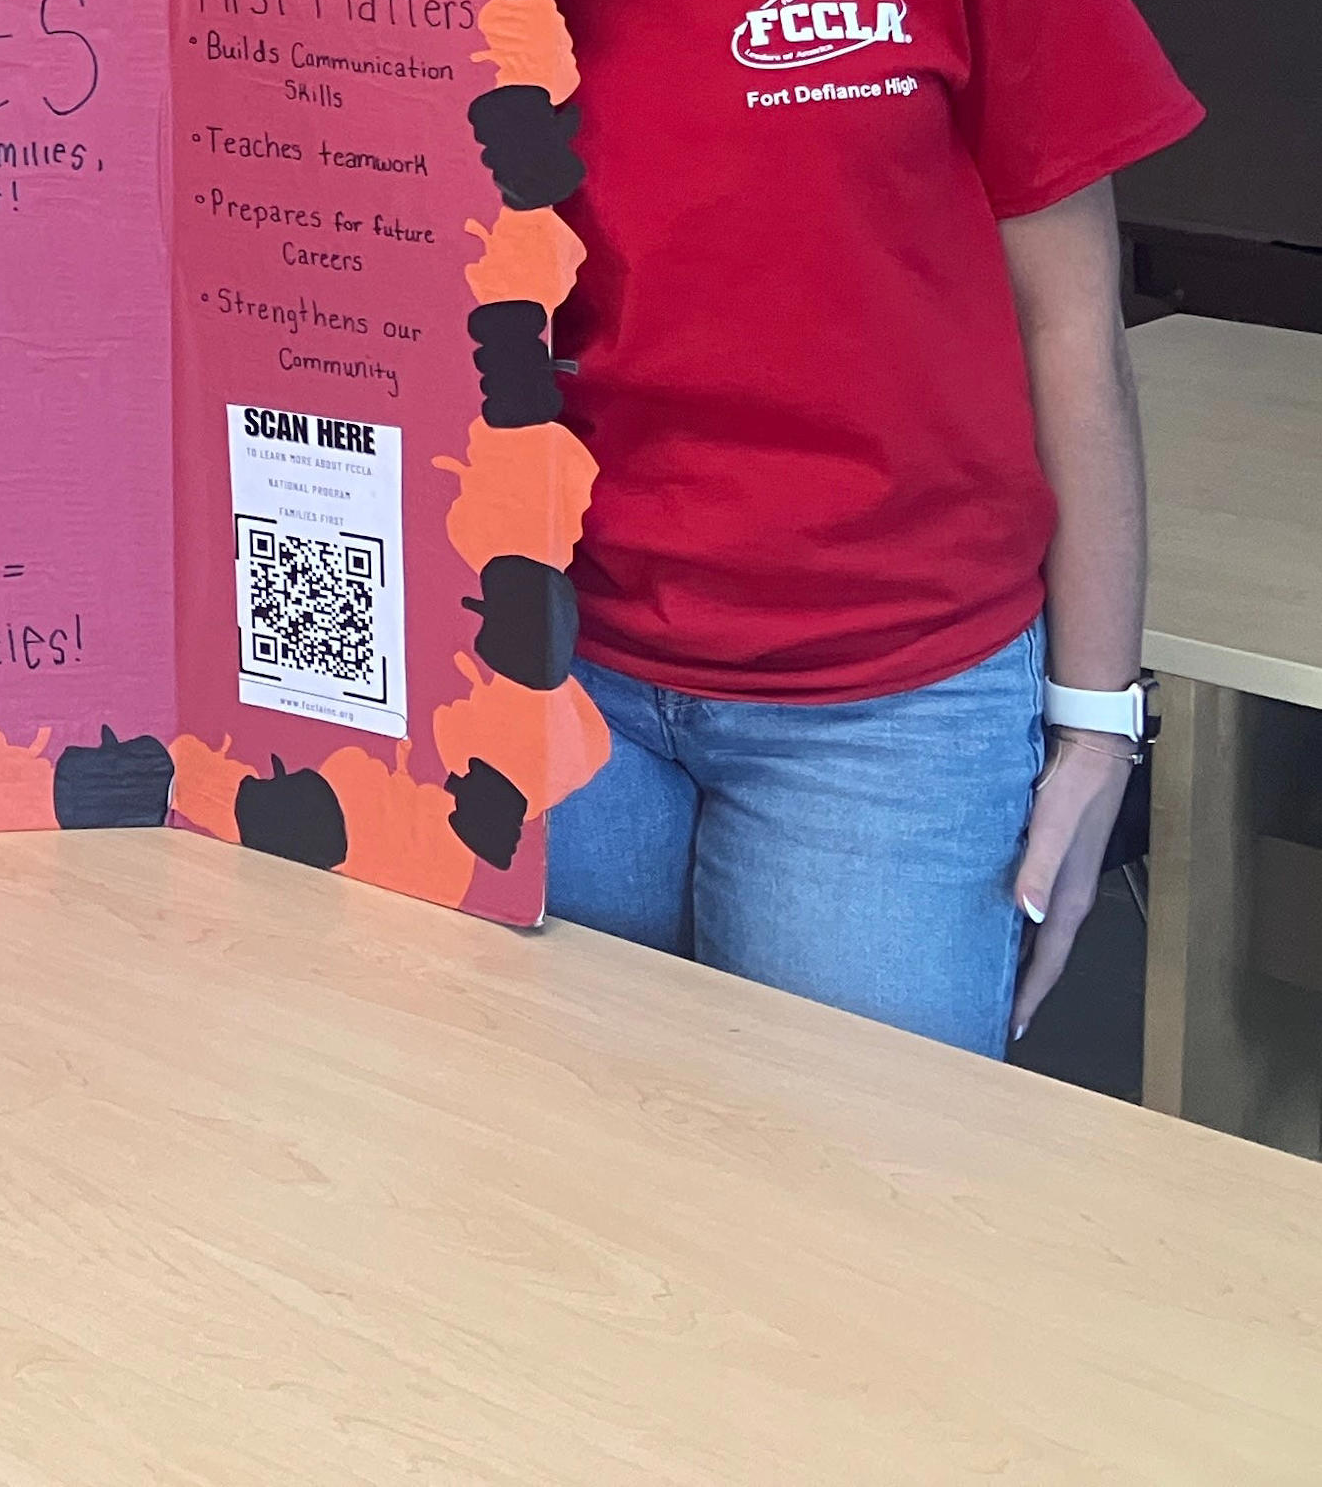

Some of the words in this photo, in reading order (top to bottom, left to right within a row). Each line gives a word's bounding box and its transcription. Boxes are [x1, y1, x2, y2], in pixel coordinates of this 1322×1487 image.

[746, 2, 907, 47] FCCLA
[207, 29, 281, 64] Builds
[290, 41, 455, 81] Communication
[747, 90, 790, 108] Fort
[794, 83, 882, 103] Defiance
[884, 75, 918, 96] High
[206, 127, 303, 161] Teaches
[210, 188, 322, 229] Prepares
[334, 212, 363, 233] for
[373, 215, 435, 244] future
[282, 242, 363, 272] Careers
[217, 288, 369, 335] Strengthens
[383, 322, 422, 342] our
[279, 348, 400, 398] Community
[244, 408, 309, 446] SCAN
[317, 418, 376, 456] HERE
[290, 454, 312, 467] MORE
